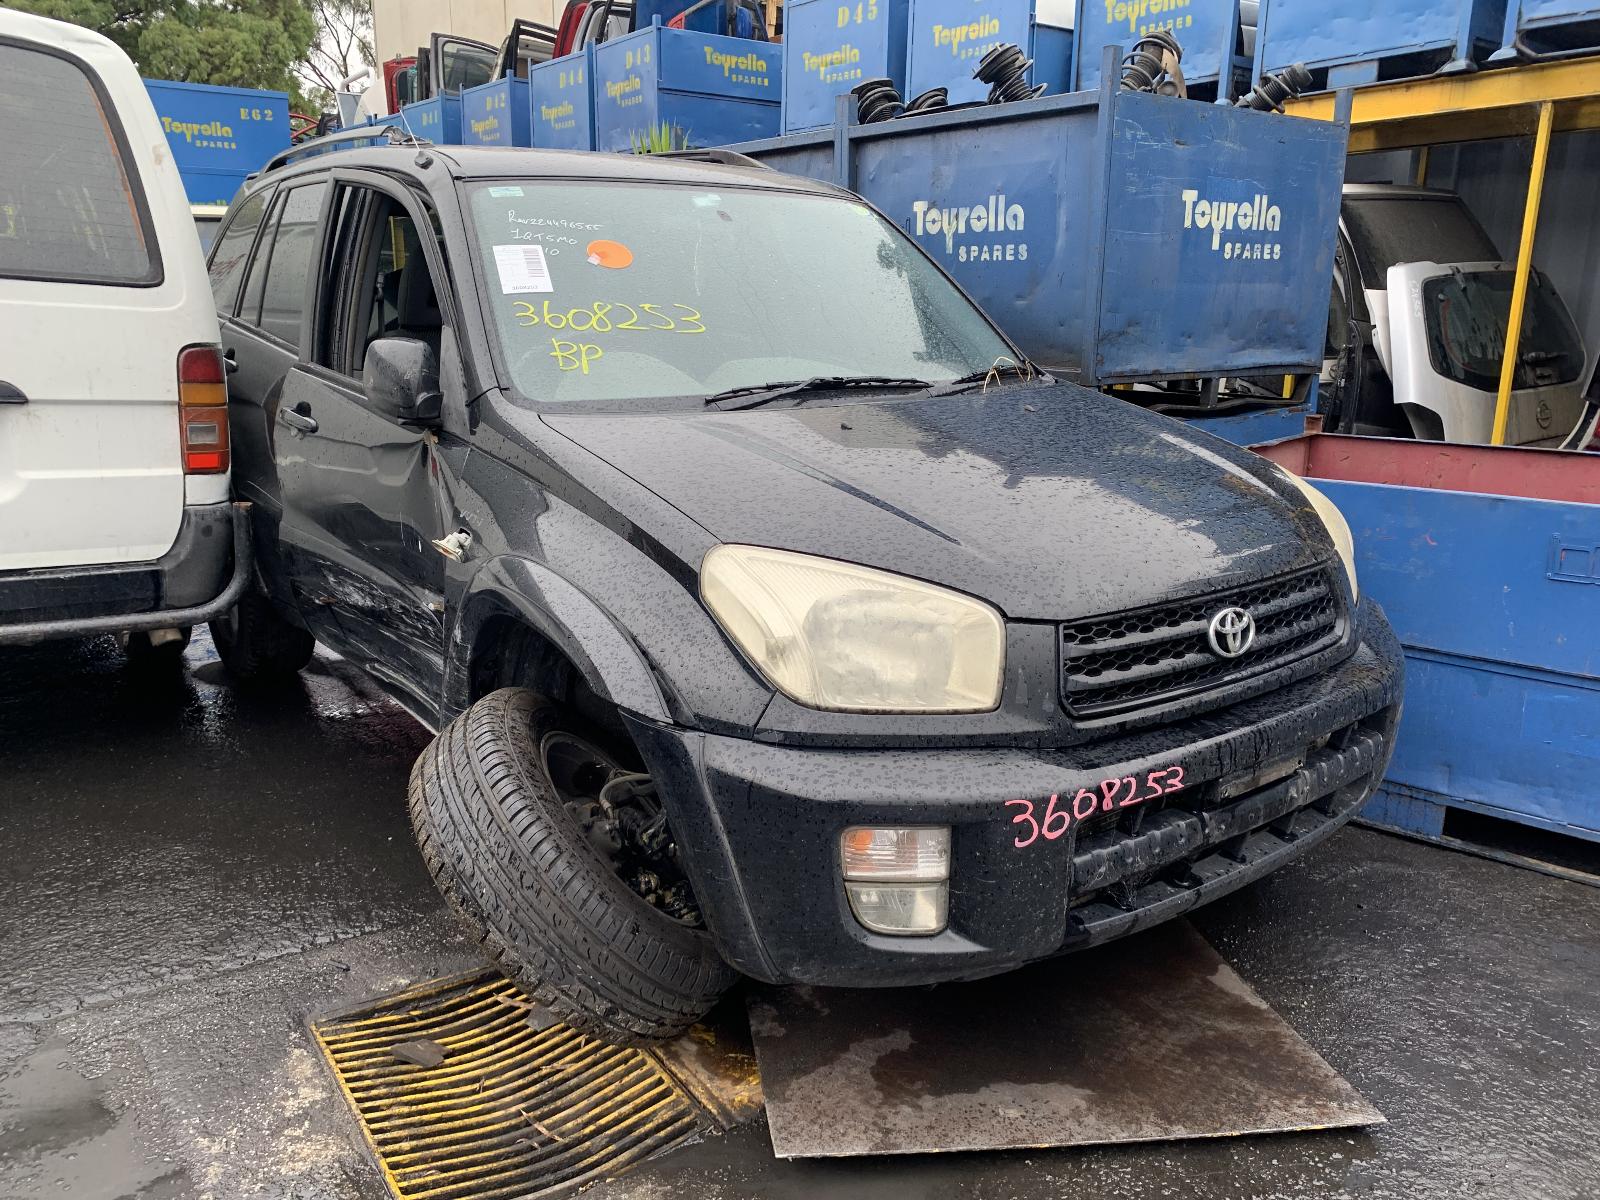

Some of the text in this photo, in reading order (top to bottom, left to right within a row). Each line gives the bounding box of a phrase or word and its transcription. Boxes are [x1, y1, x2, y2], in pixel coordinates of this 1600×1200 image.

[932, 13, 1000, 57] Toyrolla
[703, 45, 767, 77] Toyrolla
[802, 44, 860, 80] Toyrolla
[826, 68, 862, 84] SPARES
[731, 74, 769, 86] SPARES
[161, 116, 233, 142] Toyrolla
[239, 107, 273, 121] E62
[195, 139, 237, 149] SPARES
[913, 194, 1025, 254] Toyrolla
[1182, 189, 1281, 250] Toyrolla
[958, 243, 1028, 262] SPARES
[1223, 242, 1281, 260] SPARES
[513, 300, 706, 333] 3608253
[550, 338, 604, 375] BP
[1004, 766, 1185, 848] 3608253
